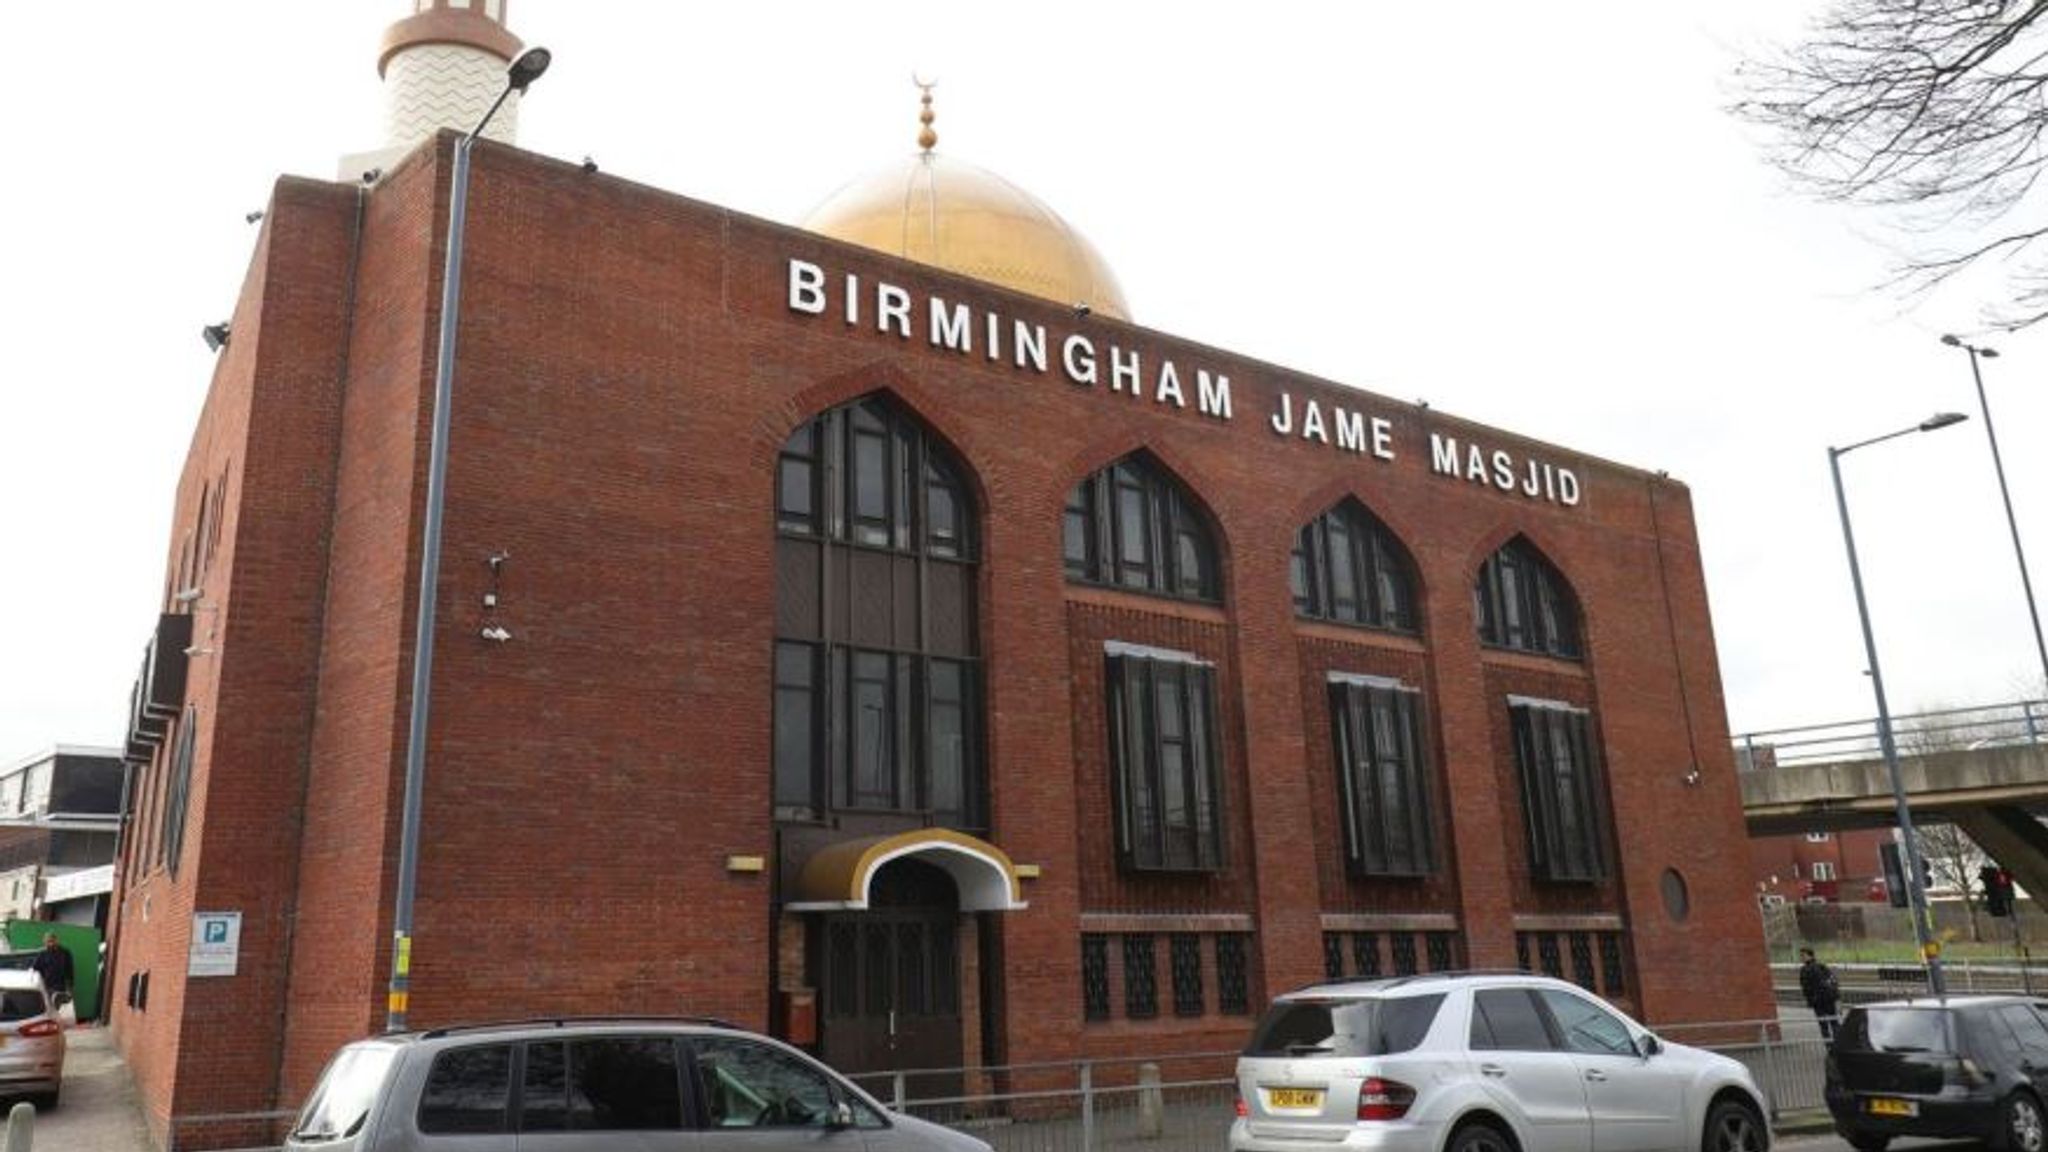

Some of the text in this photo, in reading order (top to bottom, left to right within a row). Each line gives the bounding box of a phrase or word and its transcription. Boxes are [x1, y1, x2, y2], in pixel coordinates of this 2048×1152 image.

[788, 259, 1580, 506] BIRMINGHAM JAME MASJID
[208, 923, 224, 942] P
